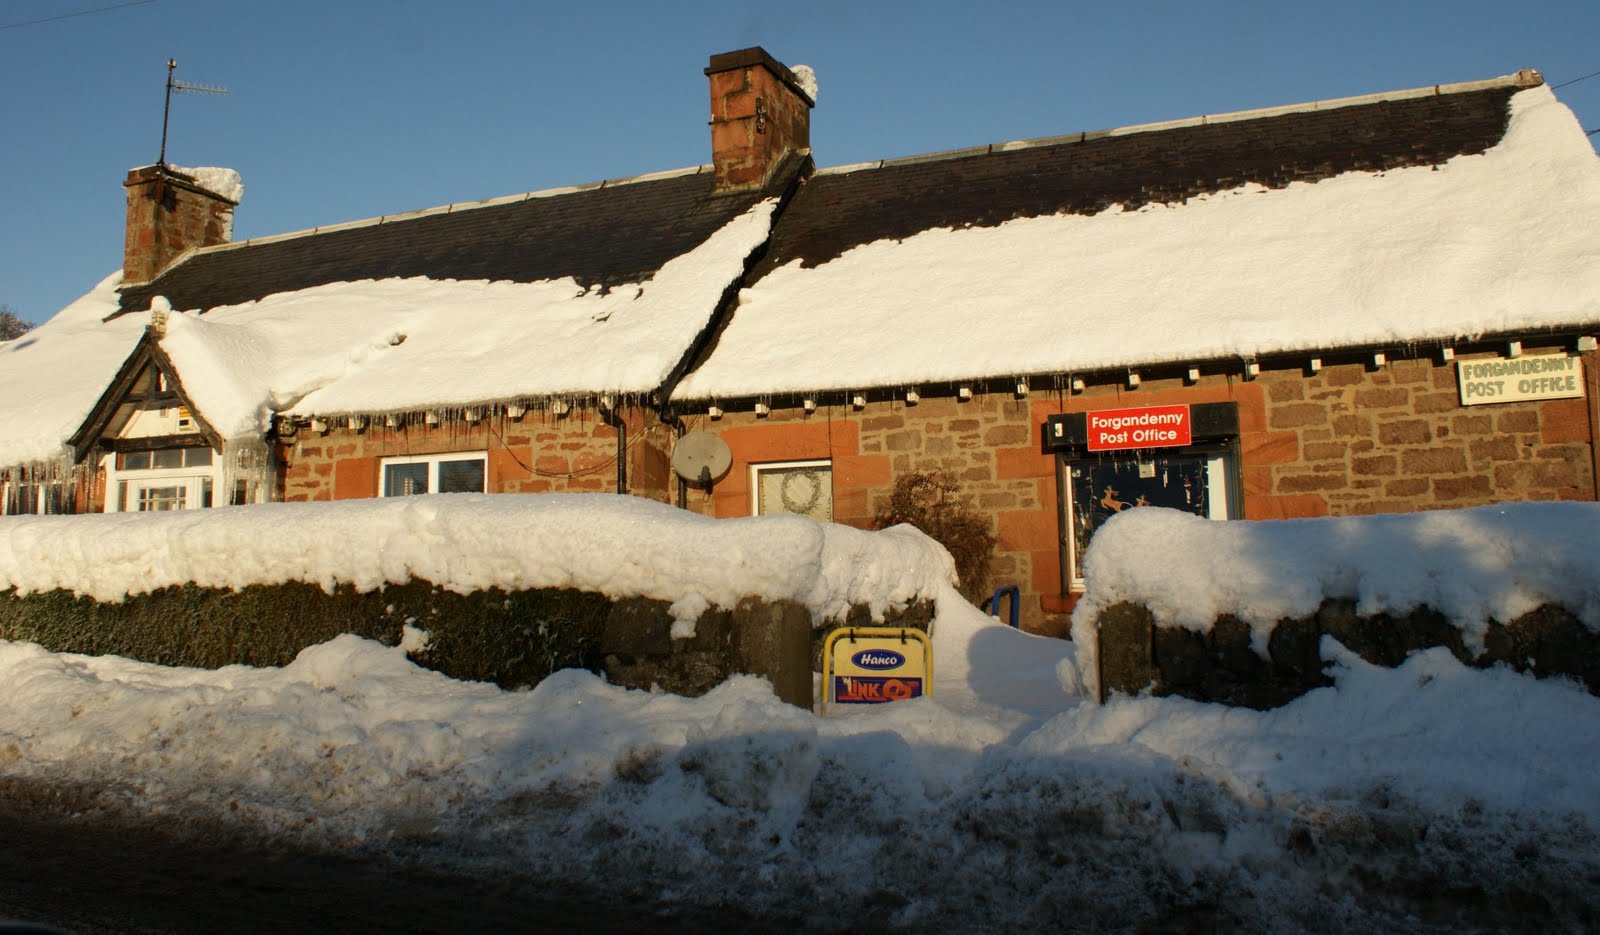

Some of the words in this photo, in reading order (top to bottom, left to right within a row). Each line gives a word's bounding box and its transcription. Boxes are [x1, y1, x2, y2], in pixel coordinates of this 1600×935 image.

[1463, 357, 1575, 380] FORGANDENNY
[1465, 381, 1505, 398] POST
[1518, 376, 1576, 394] OFFICE
[1092, 413, 1183, 430] Forgandenny
[1100, 432, 1128, 444] Post
[1133, 429, 1177, 442] Office
[861, 653, 898, 665] Hanco
